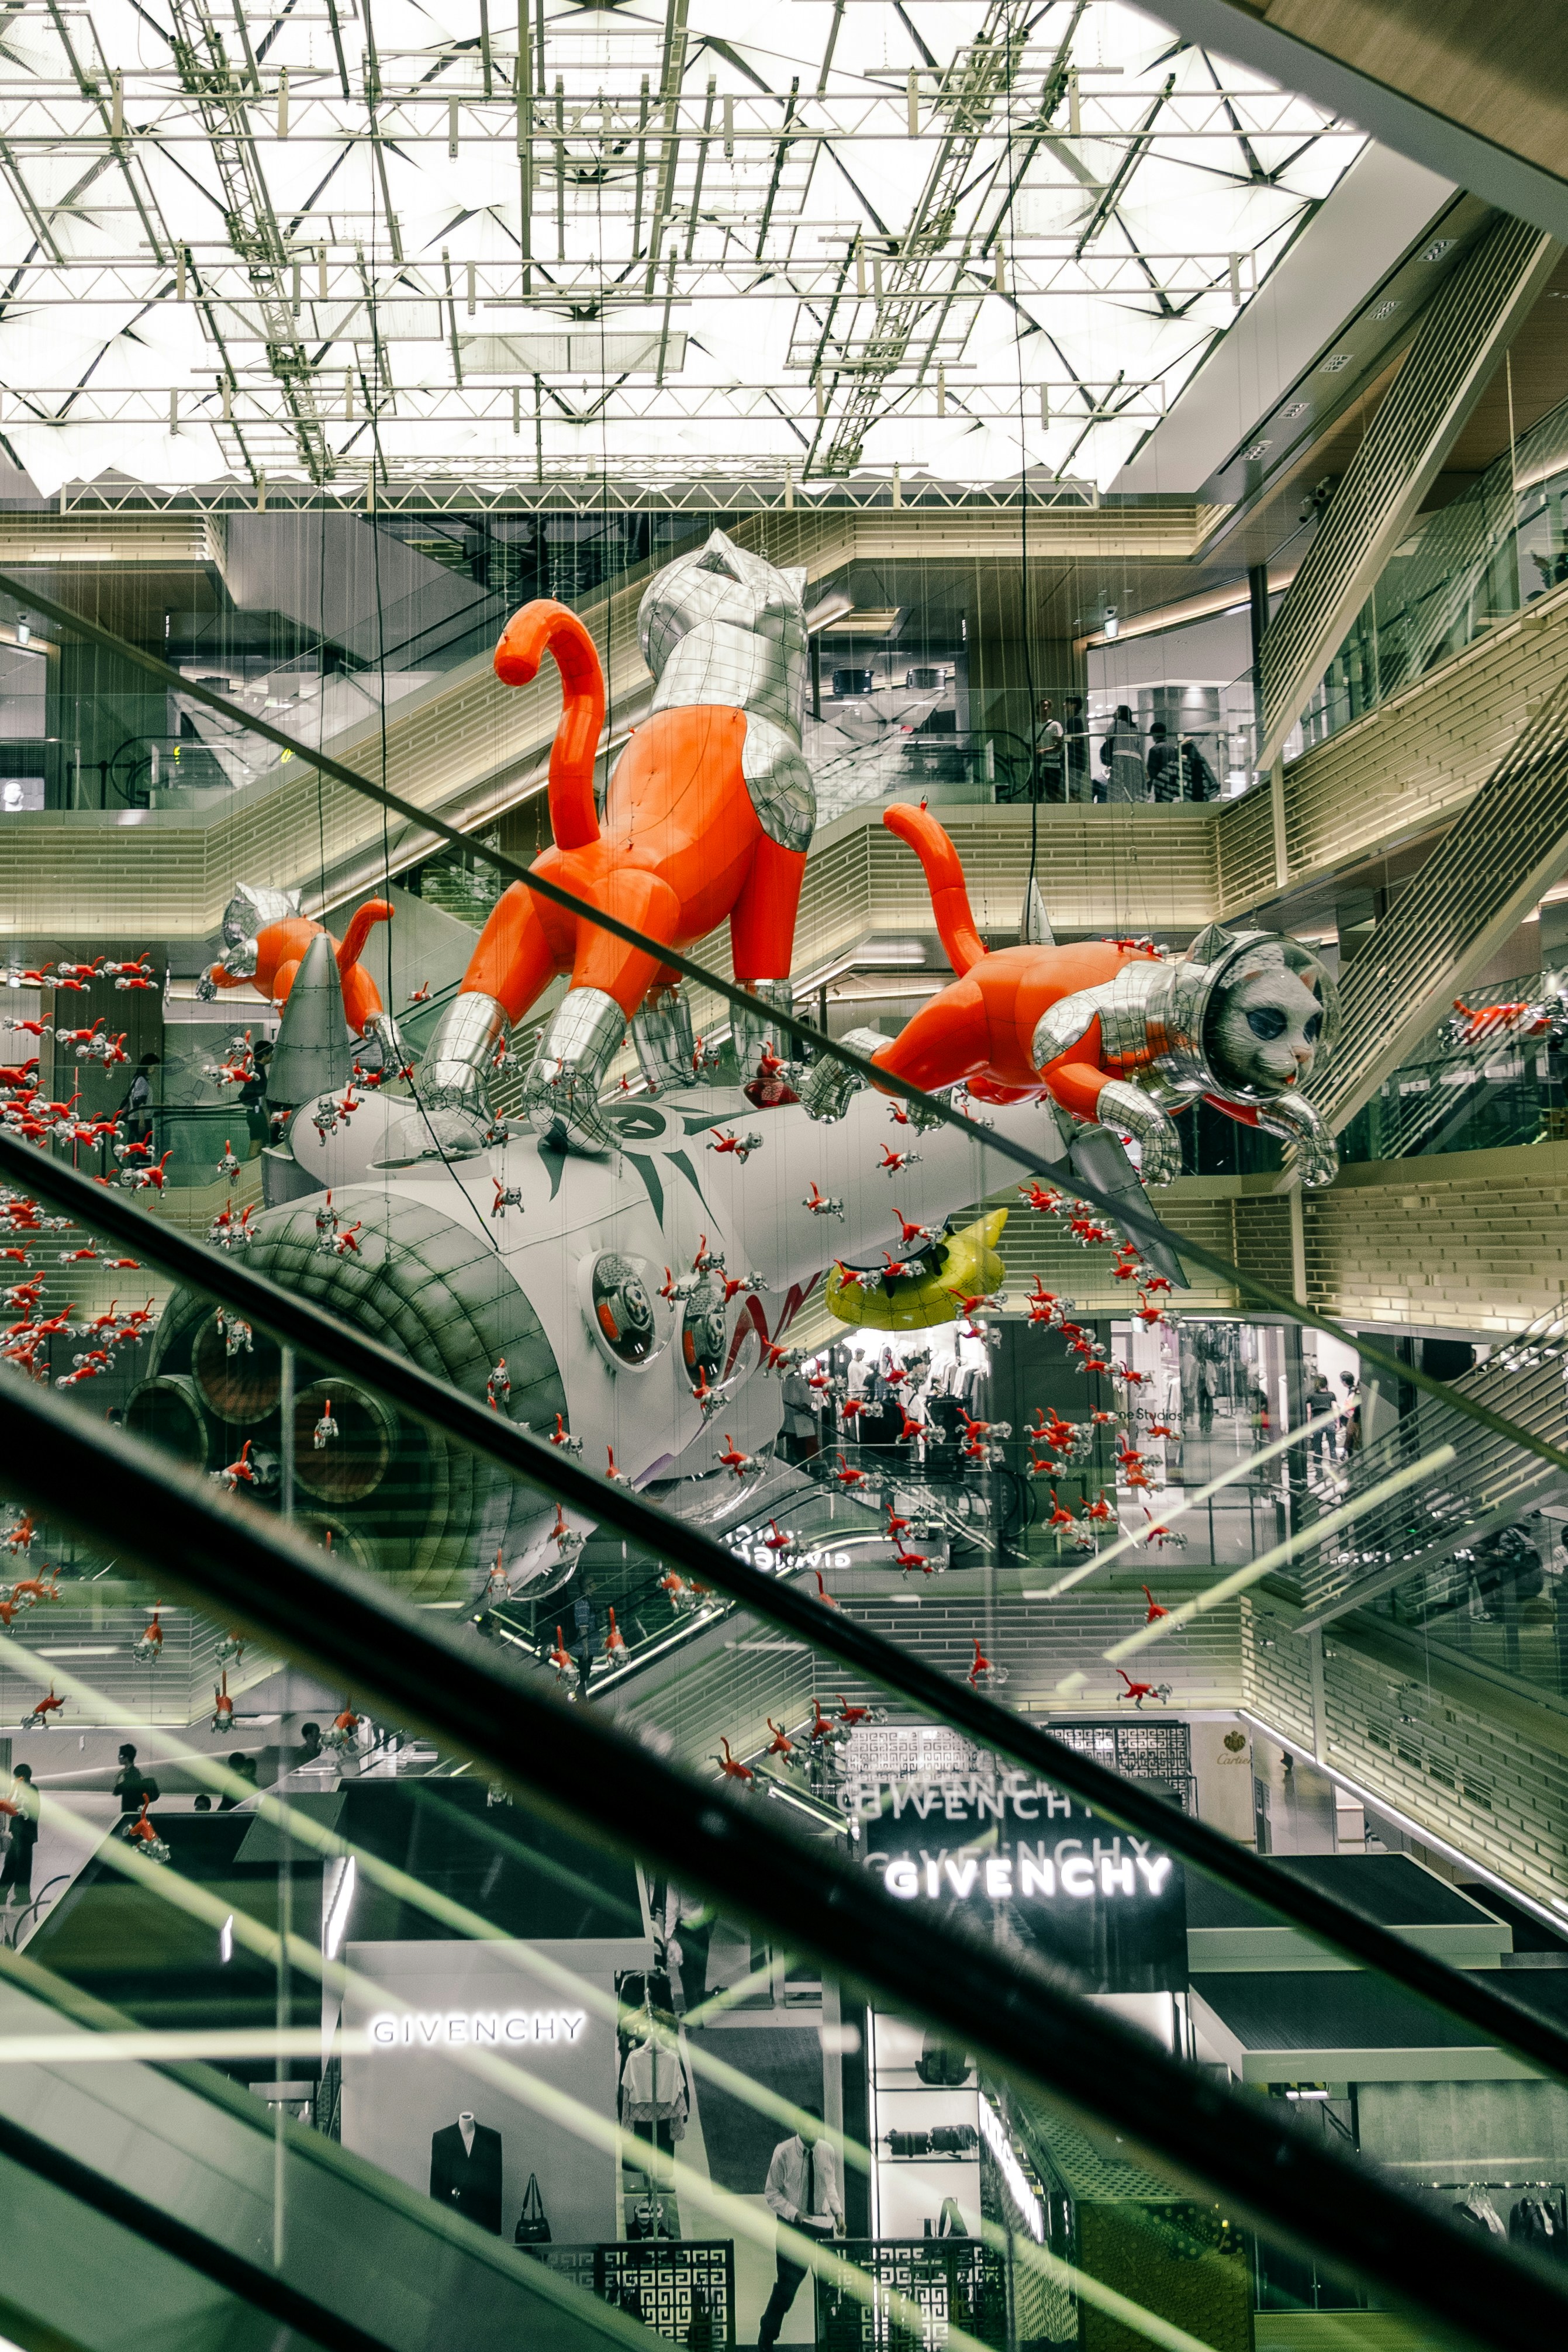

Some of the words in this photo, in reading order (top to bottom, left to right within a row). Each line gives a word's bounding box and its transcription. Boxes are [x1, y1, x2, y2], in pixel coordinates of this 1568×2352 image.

[1136, 1407, 1183, 1421] Studios
[1217, 1753, 1251, 1765] Cartier
[856, 1789, 1092, 1819] GIVENCH
[884, 1856, 1172, 1898] GIVENCHY
[372, 2016, 583, 2044] GIVENCHY
